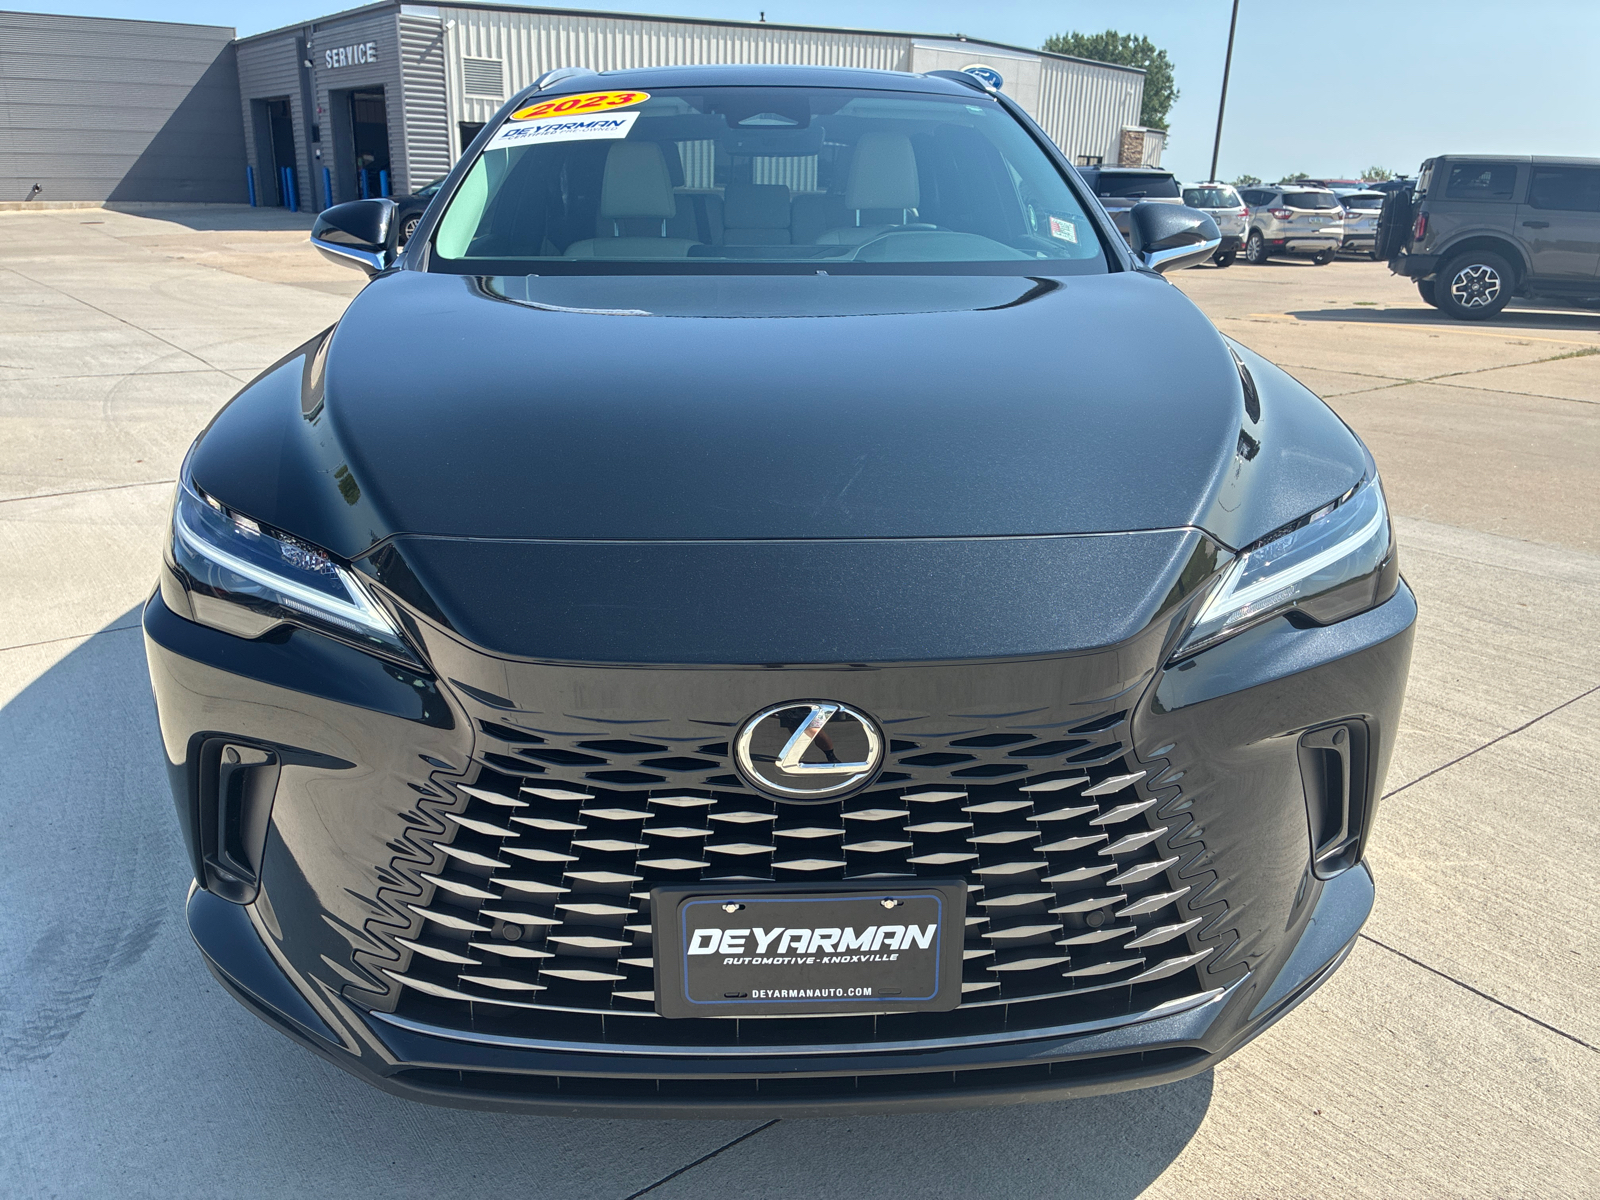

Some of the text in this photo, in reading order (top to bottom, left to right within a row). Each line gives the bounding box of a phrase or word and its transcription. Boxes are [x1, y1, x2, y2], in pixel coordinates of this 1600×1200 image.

[325, 42, 376, 68] SERVICE
[522, 93, 637, 118] 2023
[502, 119, 627, 138] DEYARMAN
[508, 130, 557, 140] CERTIFIED
[687, 924, 938, 955] DEYARMAN
[723, 953, 900, 965] AUTOMOTIVE-KNOXVILLE
[752, 987, 872, 998] DEYARMANAUTO.COM
